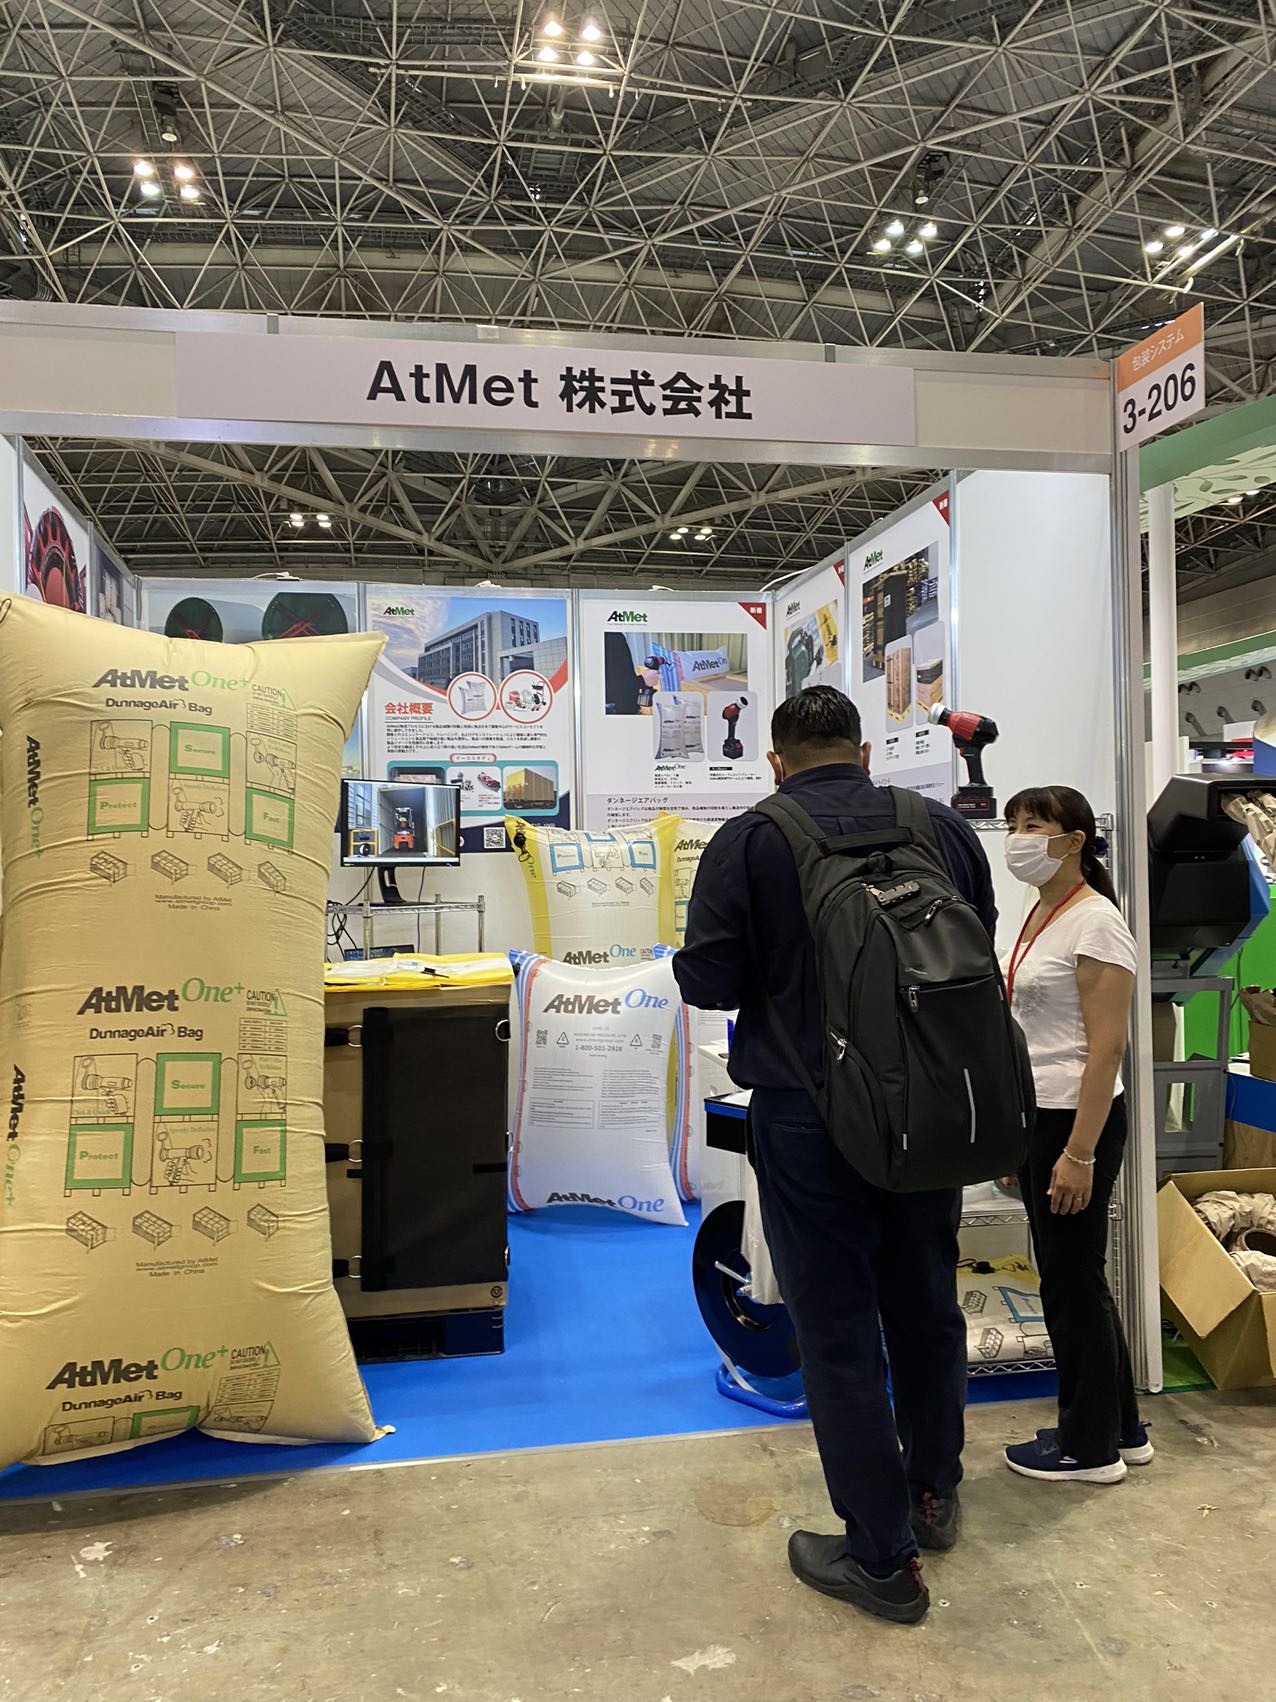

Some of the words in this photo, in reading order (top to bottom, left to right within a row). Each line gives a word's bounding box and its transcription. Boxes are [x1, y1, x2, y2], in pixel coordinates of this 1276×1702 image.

[1131, 328, 1184, 371] 包装システム
[366, 361, 539, 407] AtMet
[559, 366, 752, 420] 株式会社
[1123, 363, 1196, 434] 3-206
[383, 606, 416, 616] AtMet
[607, 610, 648, 622] AtMet
[92, 668, 189, 692] AtMet
[251, 683, 281, 696] CAUTION
[105, 697, 179, 711] DunnageAir
[188, 702, 213, 716] Bag
[384, 702, 434, 715] 会社概要
[184, 744, 216, 754] Secure
[26, 735, 41, 808] AtMet
[100, 800, 137, 810] Protect
[263, 812, 280, 823] Fast
[674, 839, 708, 852] AtMe
[677, 854, 700, 864] DunnageA
[563, 950, 609, 965] AtMet
[608, 944, 636, 957] One
[77, 984, 179, 1016] AtMet
[181, 976, 245, 1004] One+
[246, 990, 275, 1002] CAUTION
[542, 994, 622, 1015] AtMet
[624, 988, 668, 1009] One
[89, 1026, 168, 1041] DunnageAir
[177, 1026, 204, 1041] Bag
[171, 1079, 206, 1090] Secure
[7, 1063, 26, 1141] AtMet
[79, 1150, 119, 1161] Protect
[253, 1146, 272, 1155] Fast
[546, 1192, 617, 1207] AtMet
[618, 1195, 665, 1212] One
[231, 1345, 265, 1359] CAUTION
[46, 1358, 158, 1390] AtMet
[160, 1344, 229, 1372] One+
[61, 1391, 145, 1412] DunnageAir
[155, 1390, 183, 1401] Bag
